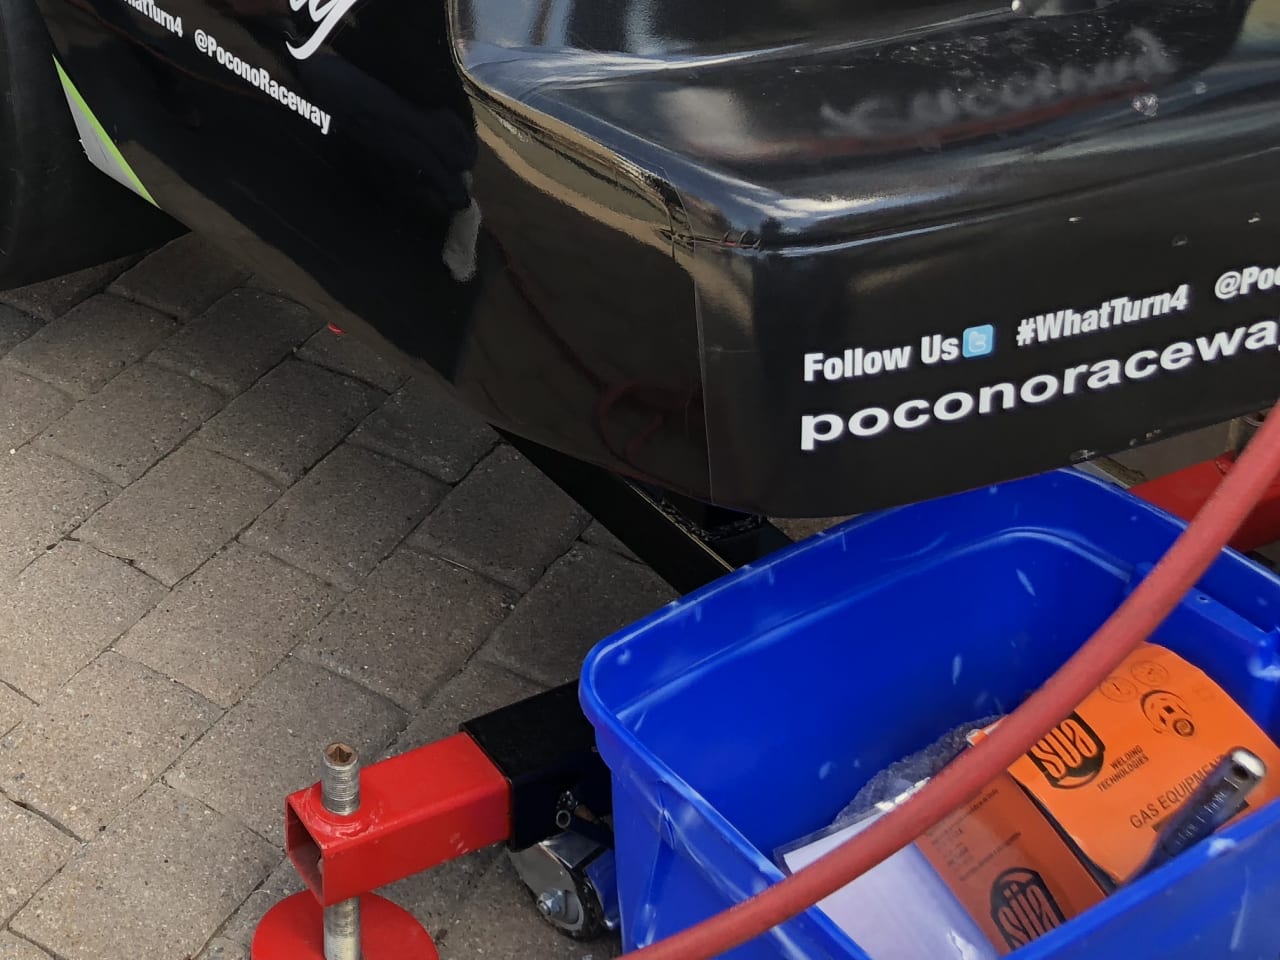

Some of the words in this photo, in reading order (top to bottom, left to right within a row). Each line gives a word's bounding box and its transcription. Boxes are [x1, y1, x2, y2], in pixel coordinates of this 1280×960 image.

[194, 28, 332, 136] @PoconoRaceway
[803, 343, 911, 382] Follow
[920, 335, 959, 364] Us
[1016, 284, 1190, 346] #WhatTurn4
[800, 320, 1280, 451] poconoracewa
[1097, 755, 1150, 792] TECHNOLOGIES
[1111, 744, 1144, 770] WELDING
[1129, 803, 1160, 830] GAS
